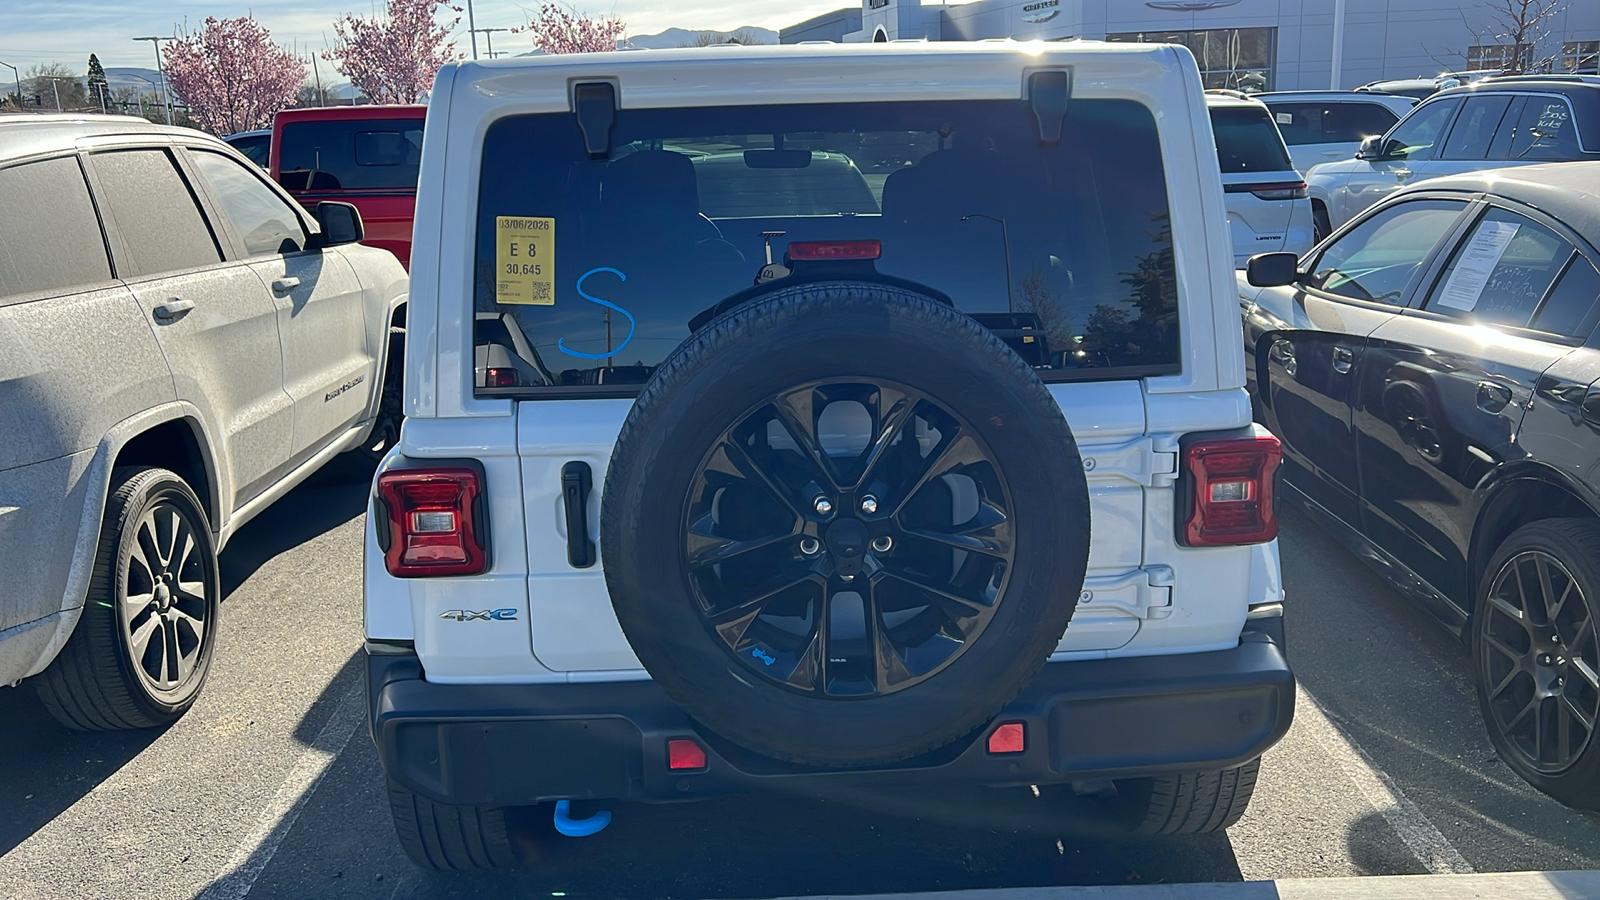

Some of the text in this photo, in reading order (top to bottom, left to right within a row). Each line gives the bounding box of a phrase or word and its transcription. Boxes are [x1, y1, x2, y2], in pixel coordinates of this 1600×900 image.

[498, 219, 550, 231] 03/06/2026
[510, 243, 536, 257] E 8
[506, 263, 541, 275] 30,645
[558, 267, 635, 359] S
